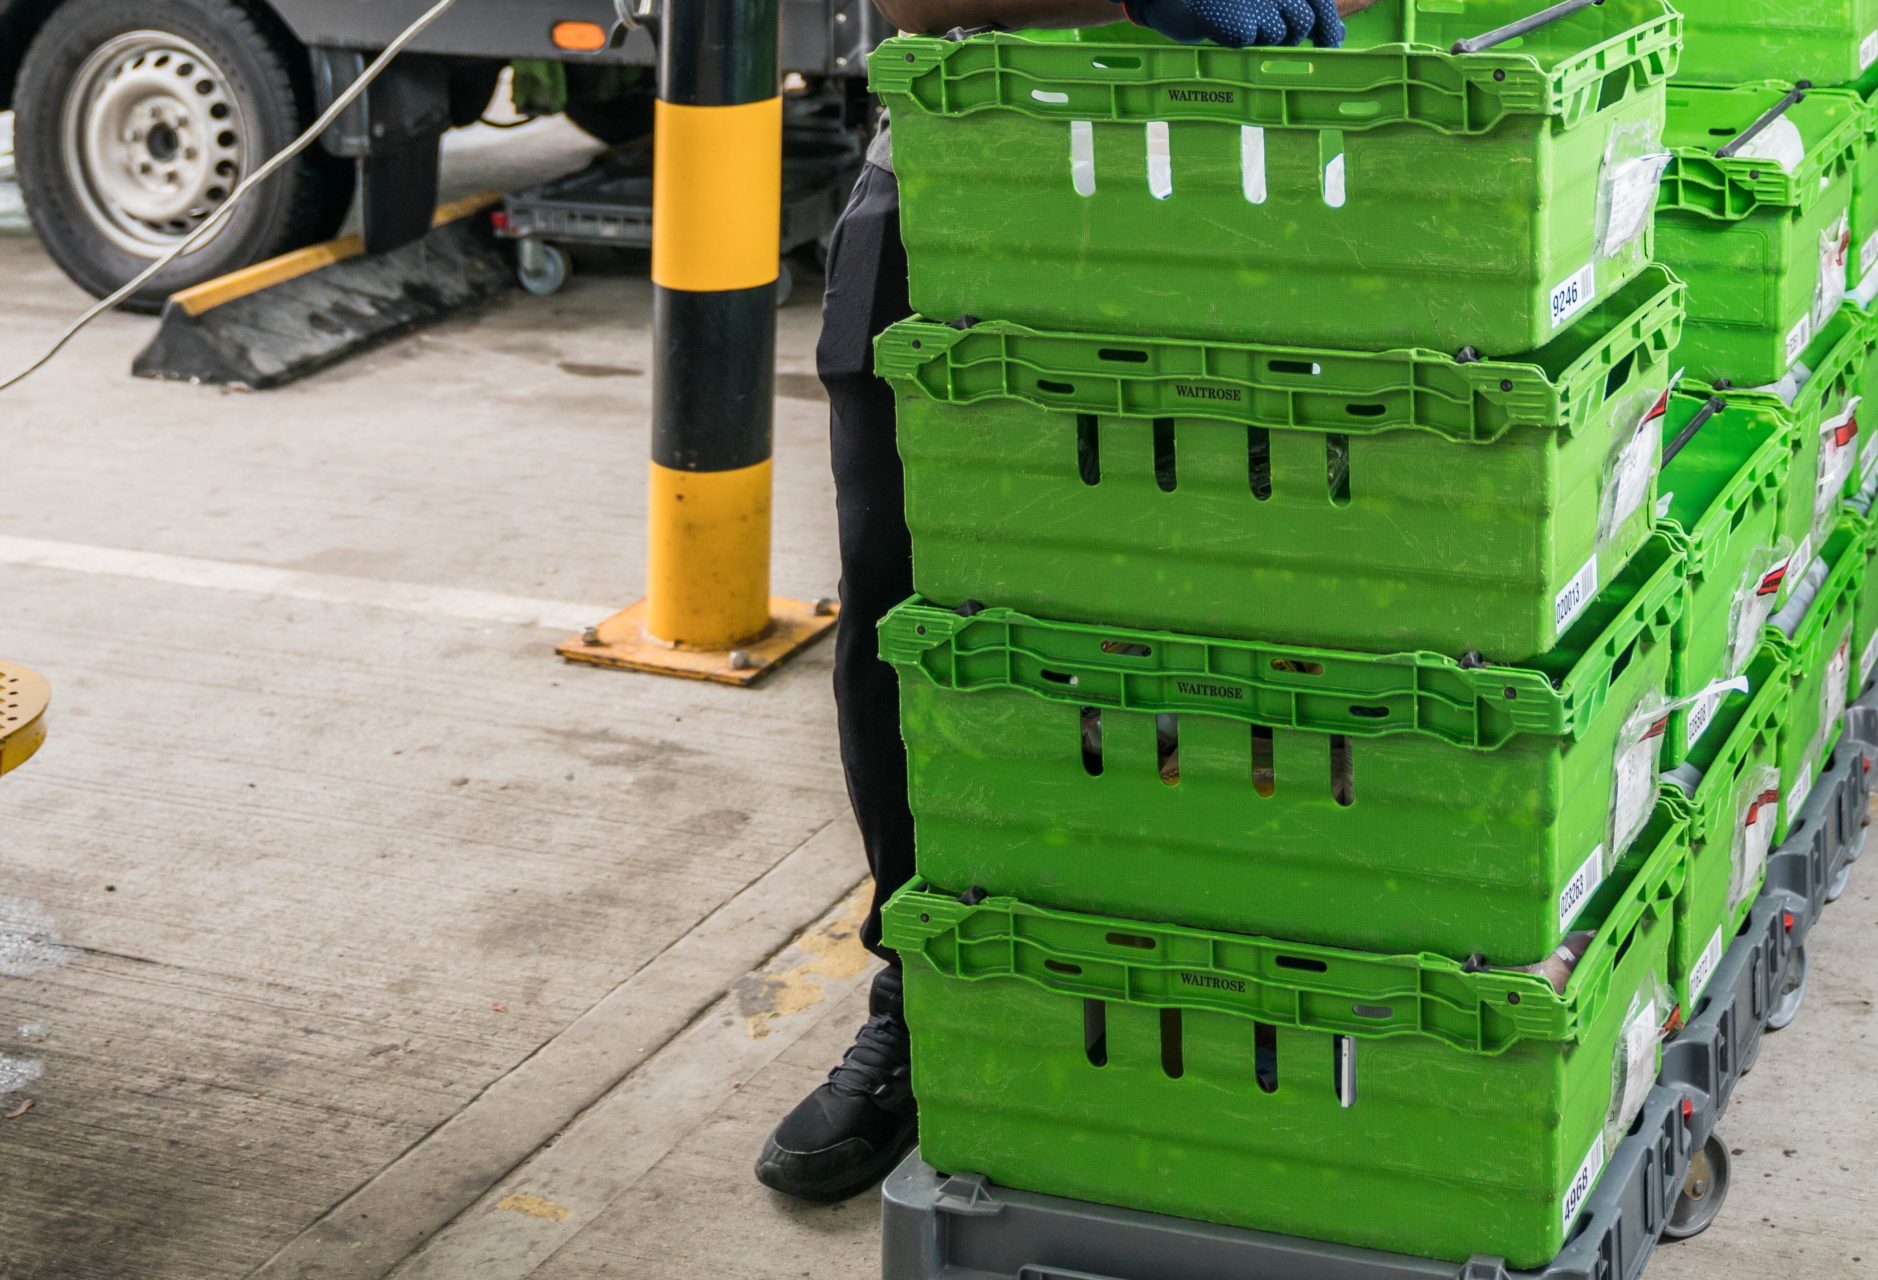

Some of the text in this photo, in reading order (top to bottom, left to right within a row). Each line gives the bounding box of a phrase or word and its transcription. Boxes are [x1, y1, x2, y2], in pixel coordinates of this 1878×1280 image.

[1168, 89, 1234, 103] WAITROSE
[1553, 281, 1578, 317] 9246
[1176, 384, 1241, 401] WAITROSE
[1556, 581, 1580, 624] 020013
[1177, 681, 1243, 700] WAITROSE
[1560, 873, 1584, 918] 023263
[1181, 972, 1246, 993] WAITROSE
[1564, 1166, 1588, 1222] 4968
